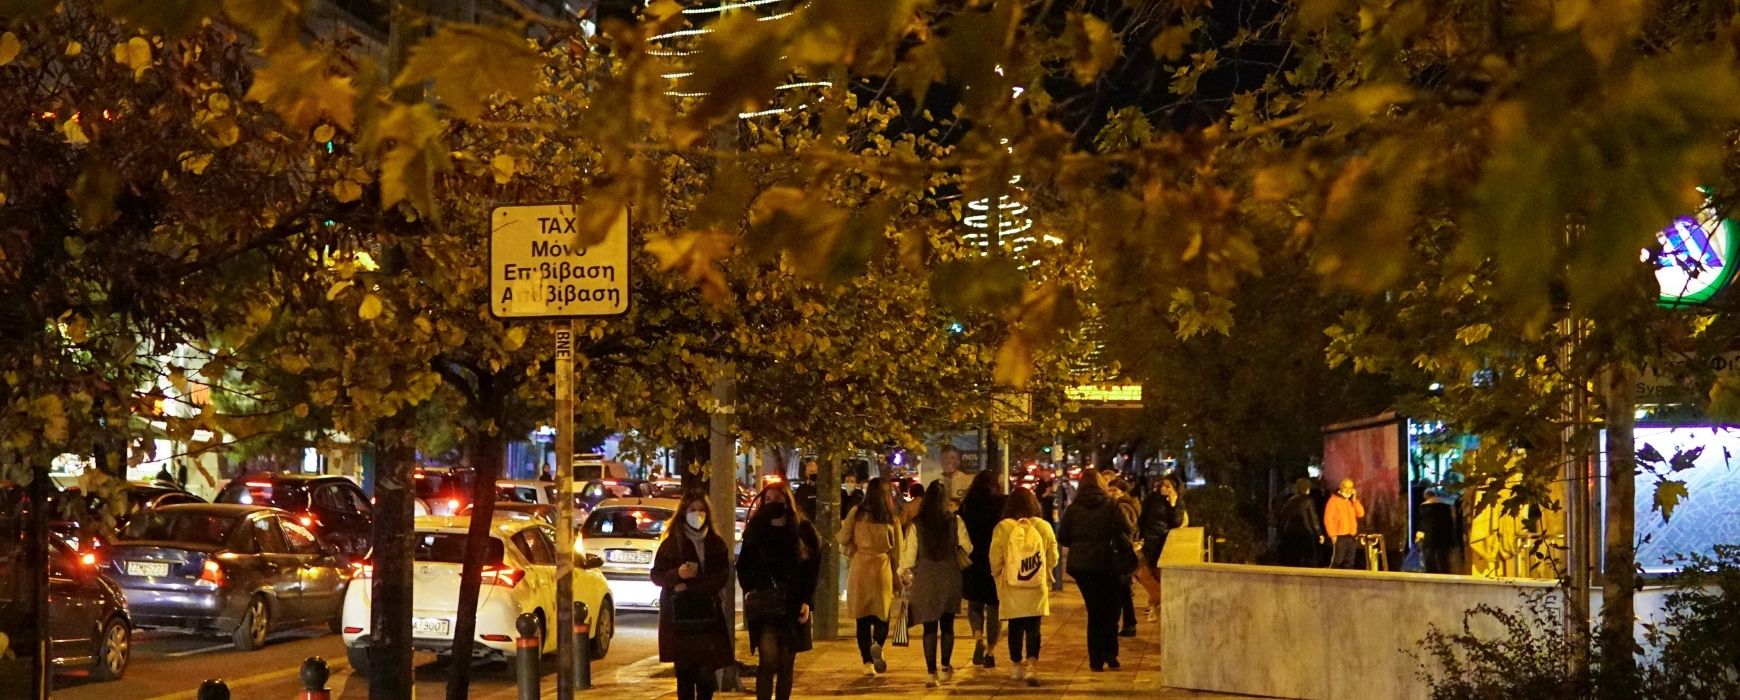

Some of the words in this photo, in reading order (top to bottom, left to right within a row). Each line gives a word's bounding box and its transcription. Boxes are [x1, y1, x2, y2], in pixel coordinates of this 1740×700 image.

[538, 217, 577, 234] TAX
[501, 285, 620, 307] Αβίβαση
[556, 331, 570, 358] BNE
